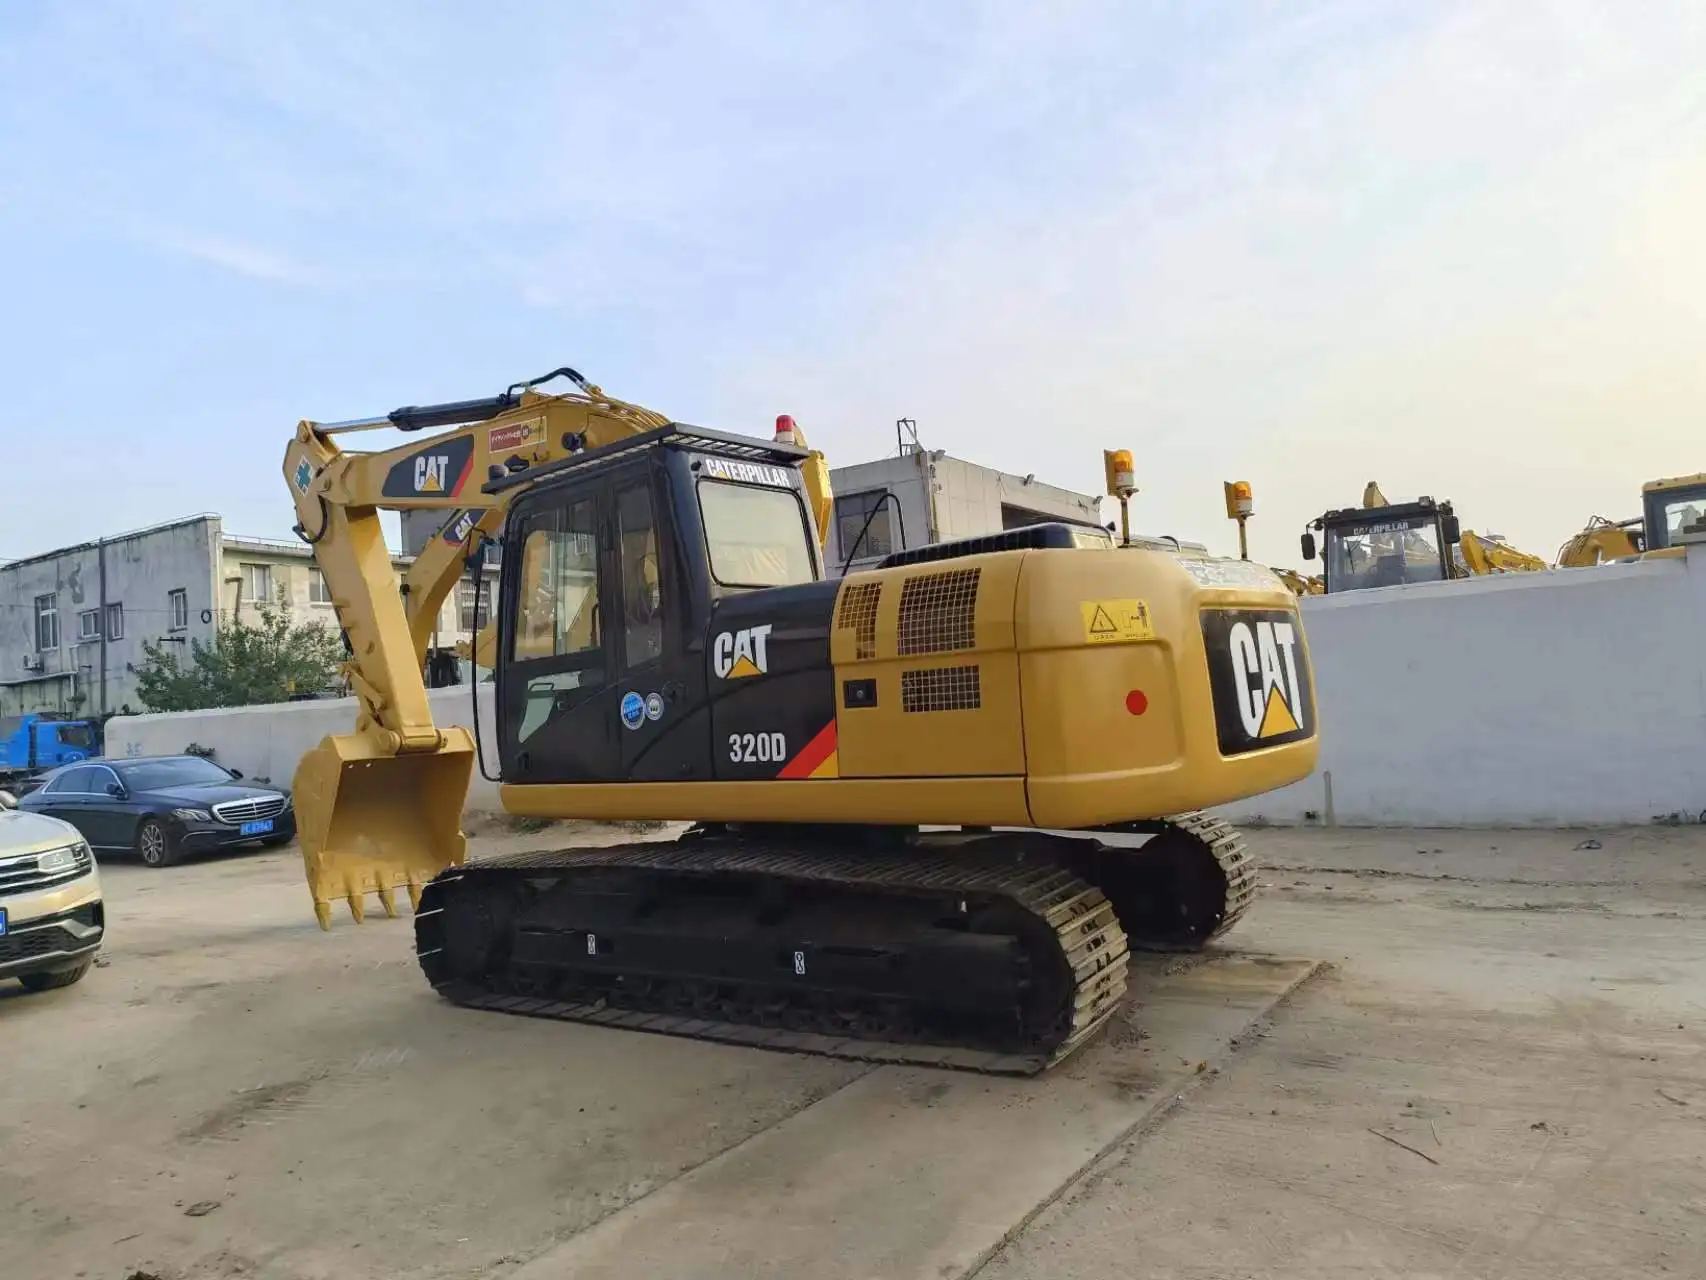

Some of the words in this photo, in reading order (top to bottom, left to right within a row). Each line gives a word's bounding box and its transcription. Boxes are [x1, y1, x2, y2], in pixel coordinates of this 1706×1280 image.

[414, 456, 449, 492] CAT
[706, 459, 790, 487] CATERPILLAR
[454, 512, 474, 541] CAT
[714, 624, 772, 680] CAT
[1230, 622, 1304, 739] CAT
[728, 732, 787, 763] 320D
